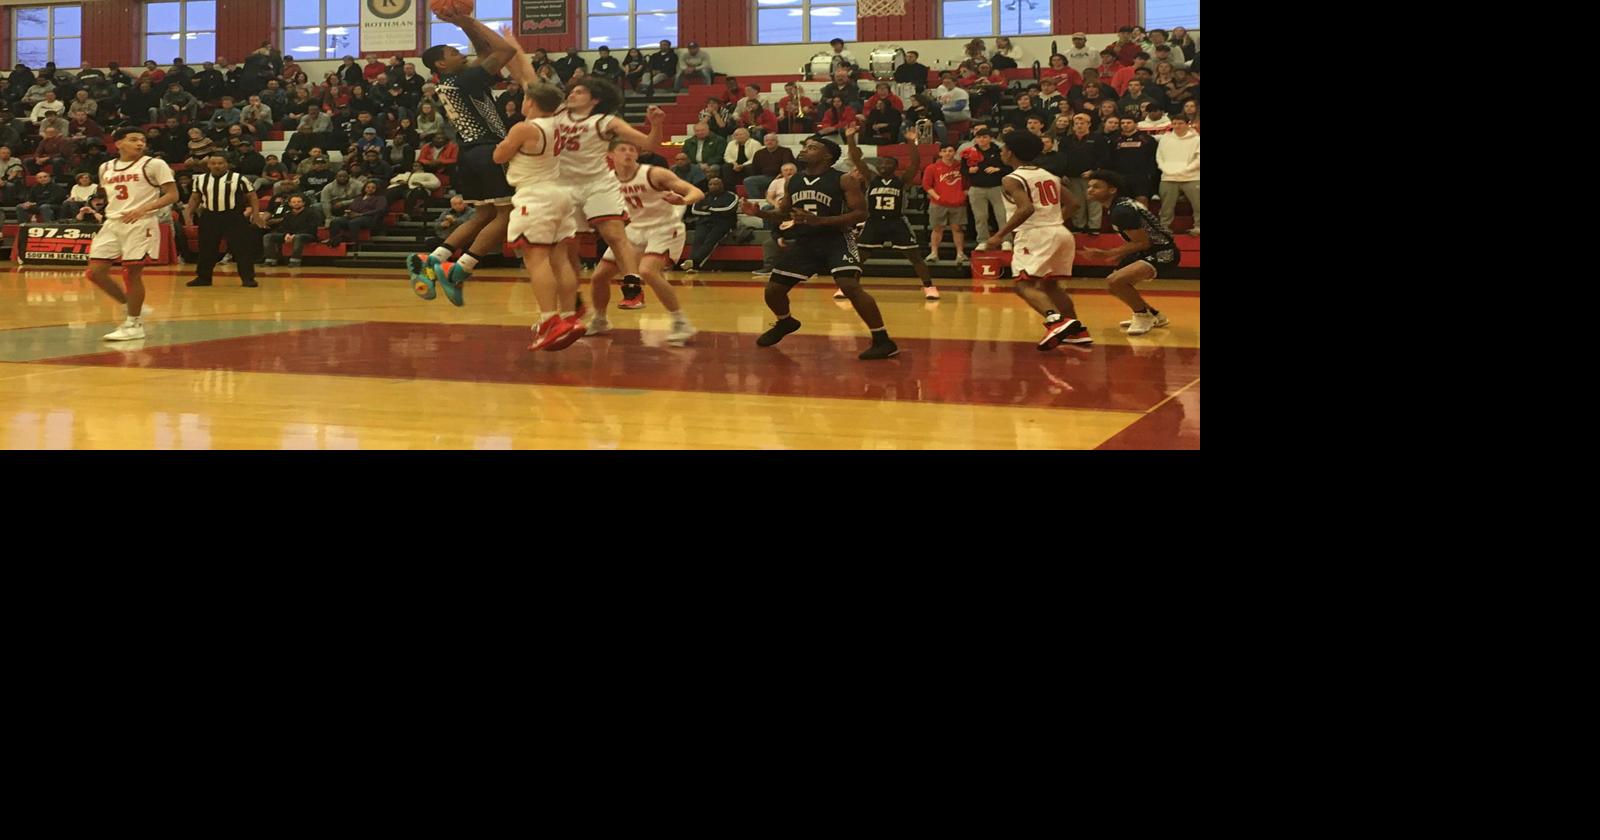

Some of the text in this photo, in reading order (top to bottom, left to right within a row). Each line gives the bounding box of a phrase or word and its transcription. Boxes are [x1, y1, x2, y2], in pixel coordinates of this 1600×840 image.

[115, 185, 129, 200] 3
[1035, 179, 1058, 206] 10
[875, 196, 895, 210] 13
[27, 227, 81, 238] 97.3
[982, 265, 995, 275] L
